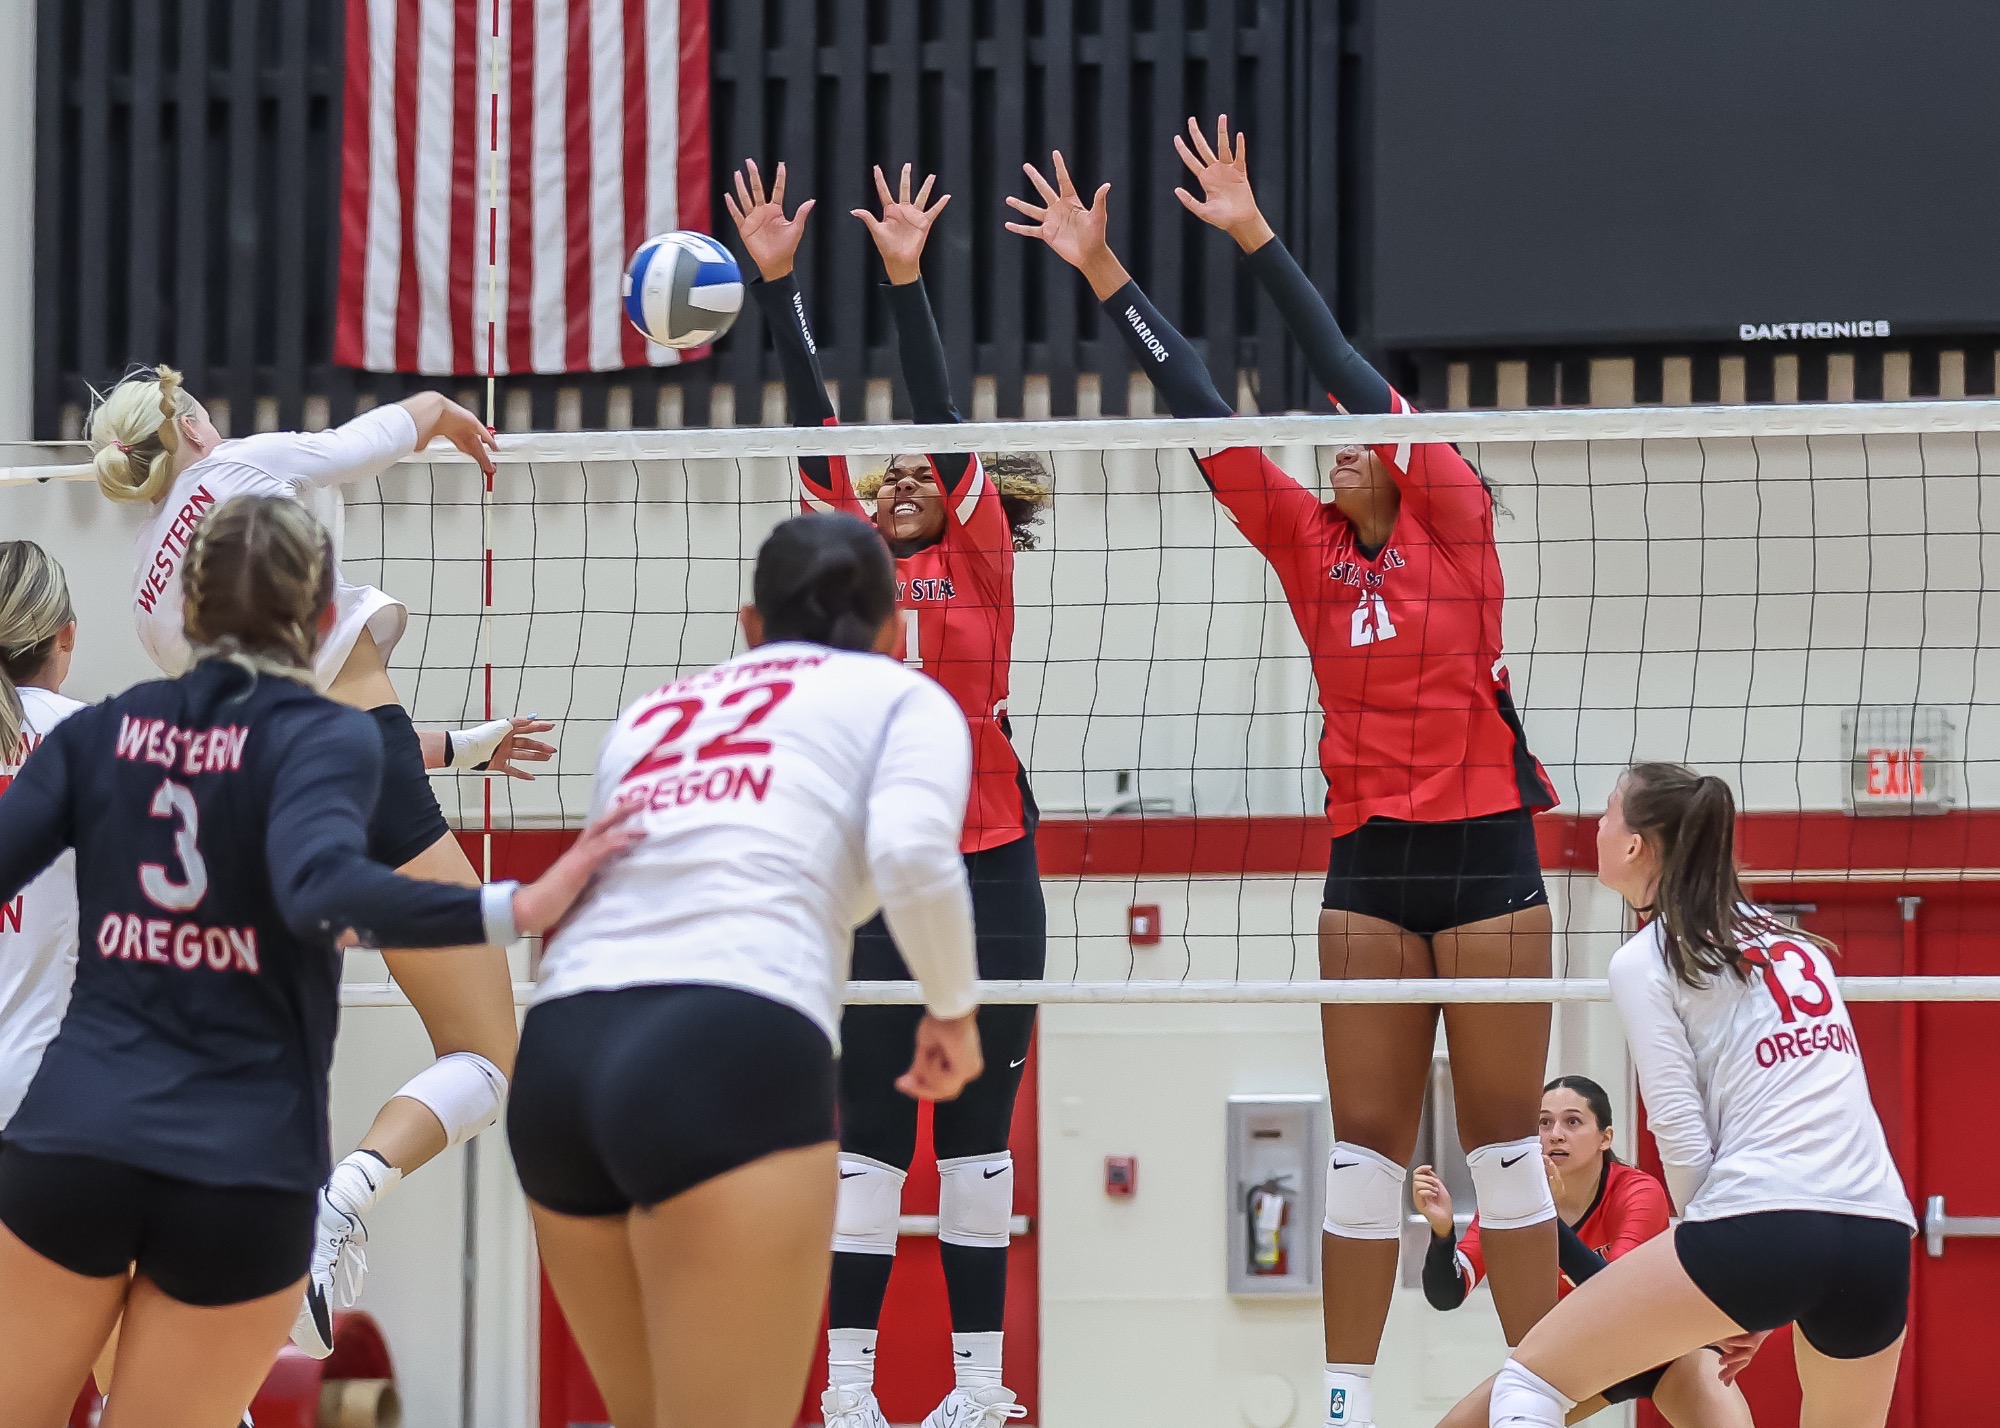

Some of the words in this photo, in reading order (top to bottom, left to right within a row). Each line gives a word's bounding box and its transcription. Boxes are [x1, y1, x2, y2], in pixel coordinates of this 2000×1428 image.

[793, 291, 817, 355] WARRIORS
[1124, 304, 1170, 363] WARRIORS
[1738, 320, 1891, 341] DAKTRONICS
[137, 484, 216, 615] WESTERN
[1350, 588, 1398, 648] 21
[115, 713, 250, 775] WESTERN
[619, 680, 795, 784] 22
[1866, 747, 1928, 796] EXIT
[137, 777, 208, 912] 3
[97, 911, 261, 974] OREGON
[1736, 940, 1833, 1024] 13
[1755, 1023, 1858, 1069] OREGON
